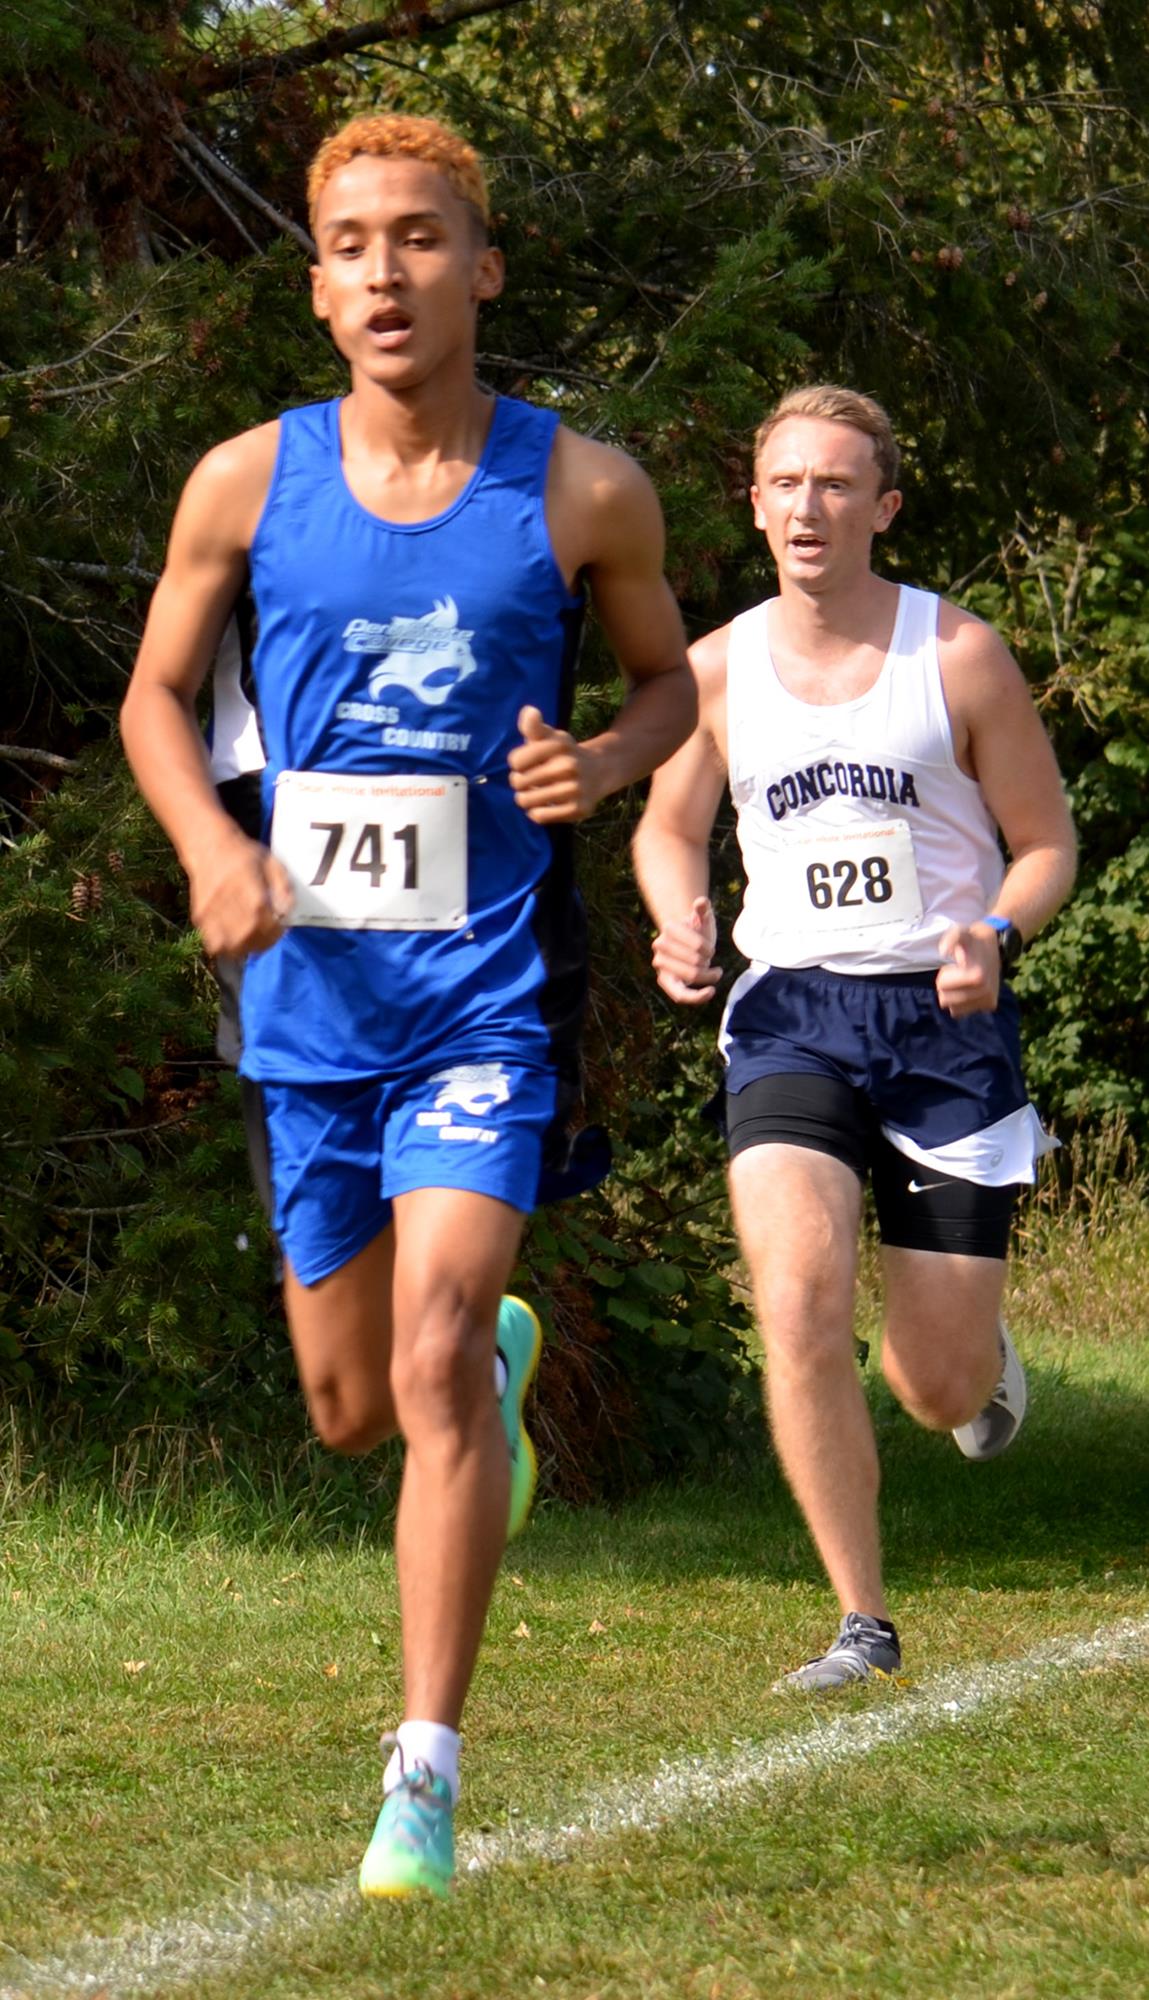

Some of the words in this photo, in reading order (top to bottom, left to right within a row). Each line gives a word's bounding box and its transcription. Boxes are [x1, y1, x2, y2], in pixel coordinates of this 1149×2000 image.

[344, 633, 451, 654] College
[335, 702, 399, 724] CROSS
[382, 728, 471, 751] COUNTRY
[766, 762, 920, 821] CONCORDIA
[310, 821, 419, 889] 741
[806, 856, 893, 910] 628
